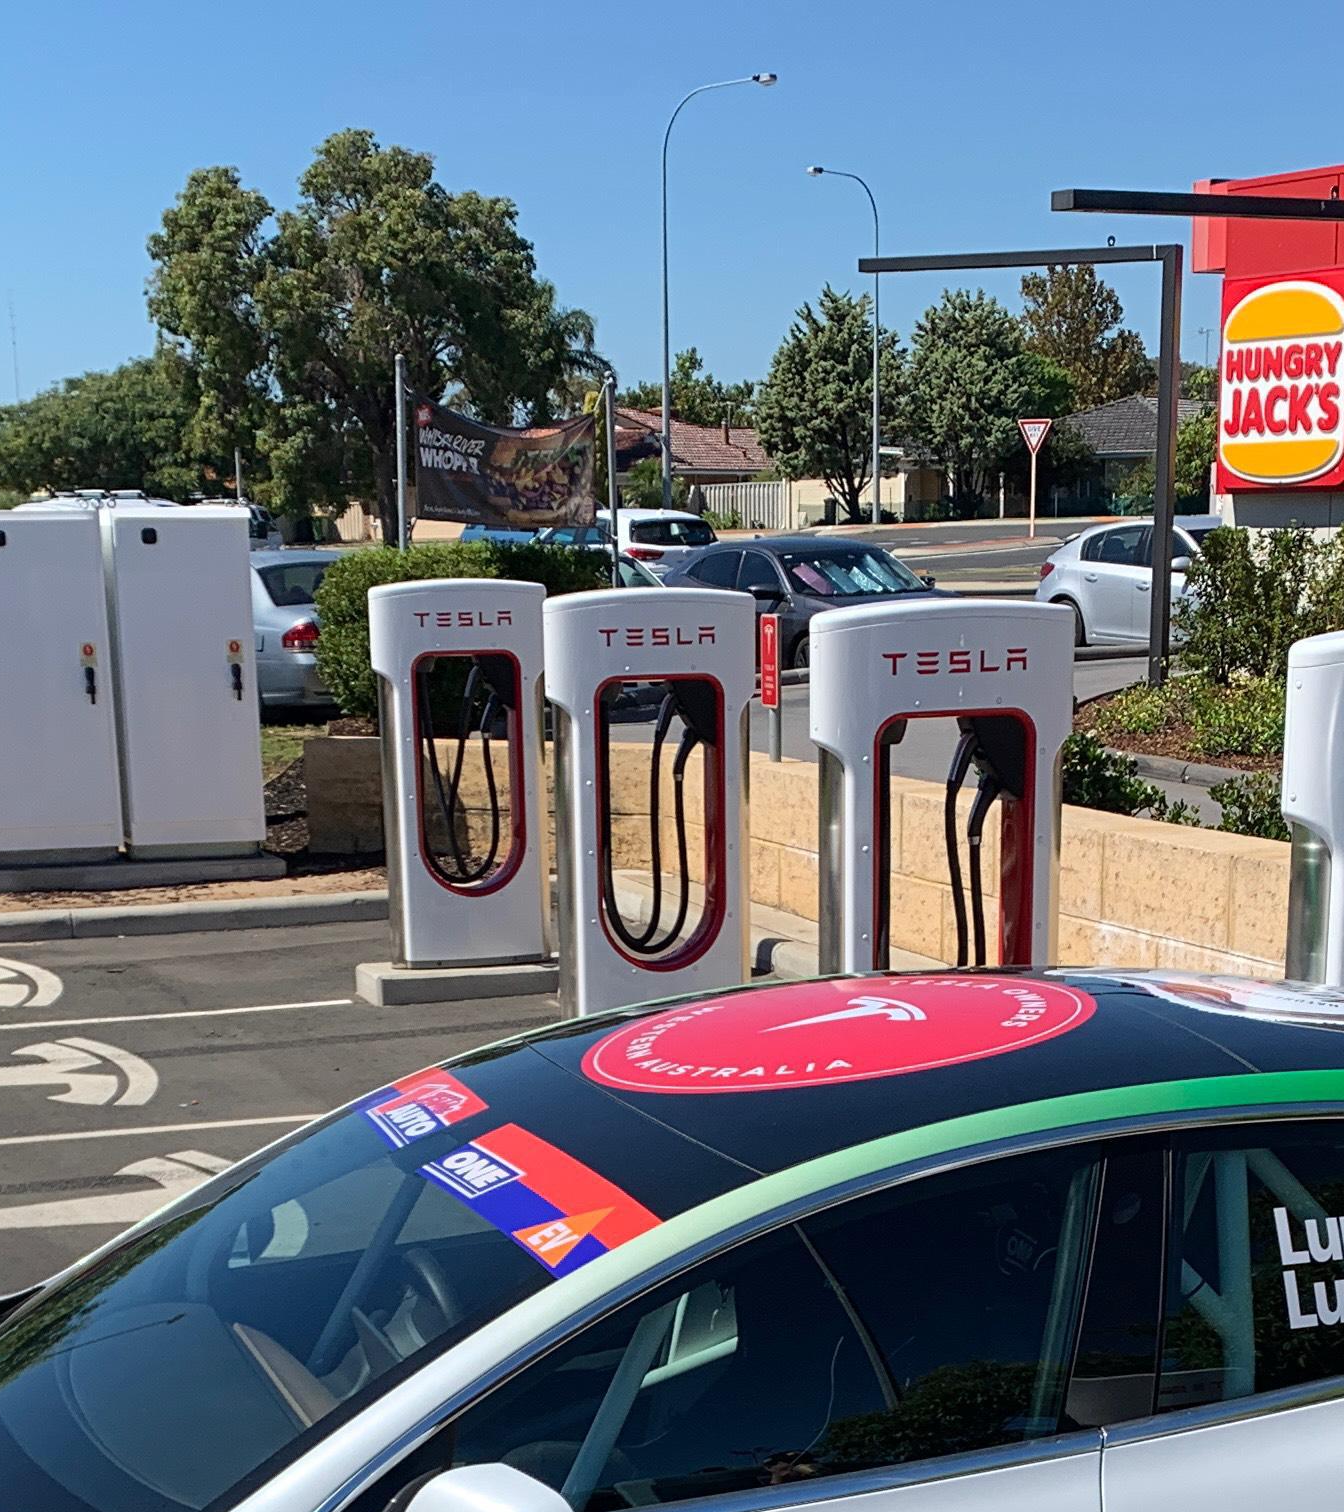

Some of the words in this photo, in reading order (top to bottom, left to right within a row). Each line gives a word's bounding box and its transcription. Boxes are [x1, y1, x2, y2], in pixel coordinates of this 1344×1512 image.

[1226, 341, 1342, 384] HUNGRY
[1224, 382, 1340, 438] JACK'S
[413, 610, 512, 627] TESLA
[598, 626, 716, 647] TESLA
[881, 648, 1028, 676] TESLA
[889, 980, 999, 990] TESLA
[1000, 988, 1048, 1028] OWNERS
[626, 1005, 724, 1061] WESTERN
[634, 1058, 853, 1079] AUSTRALIA
[384, 1103, 438, 1138] AUTO
[442, 1151, 511, 1189] ONE
[527, 1221, 581, 1253] EV
